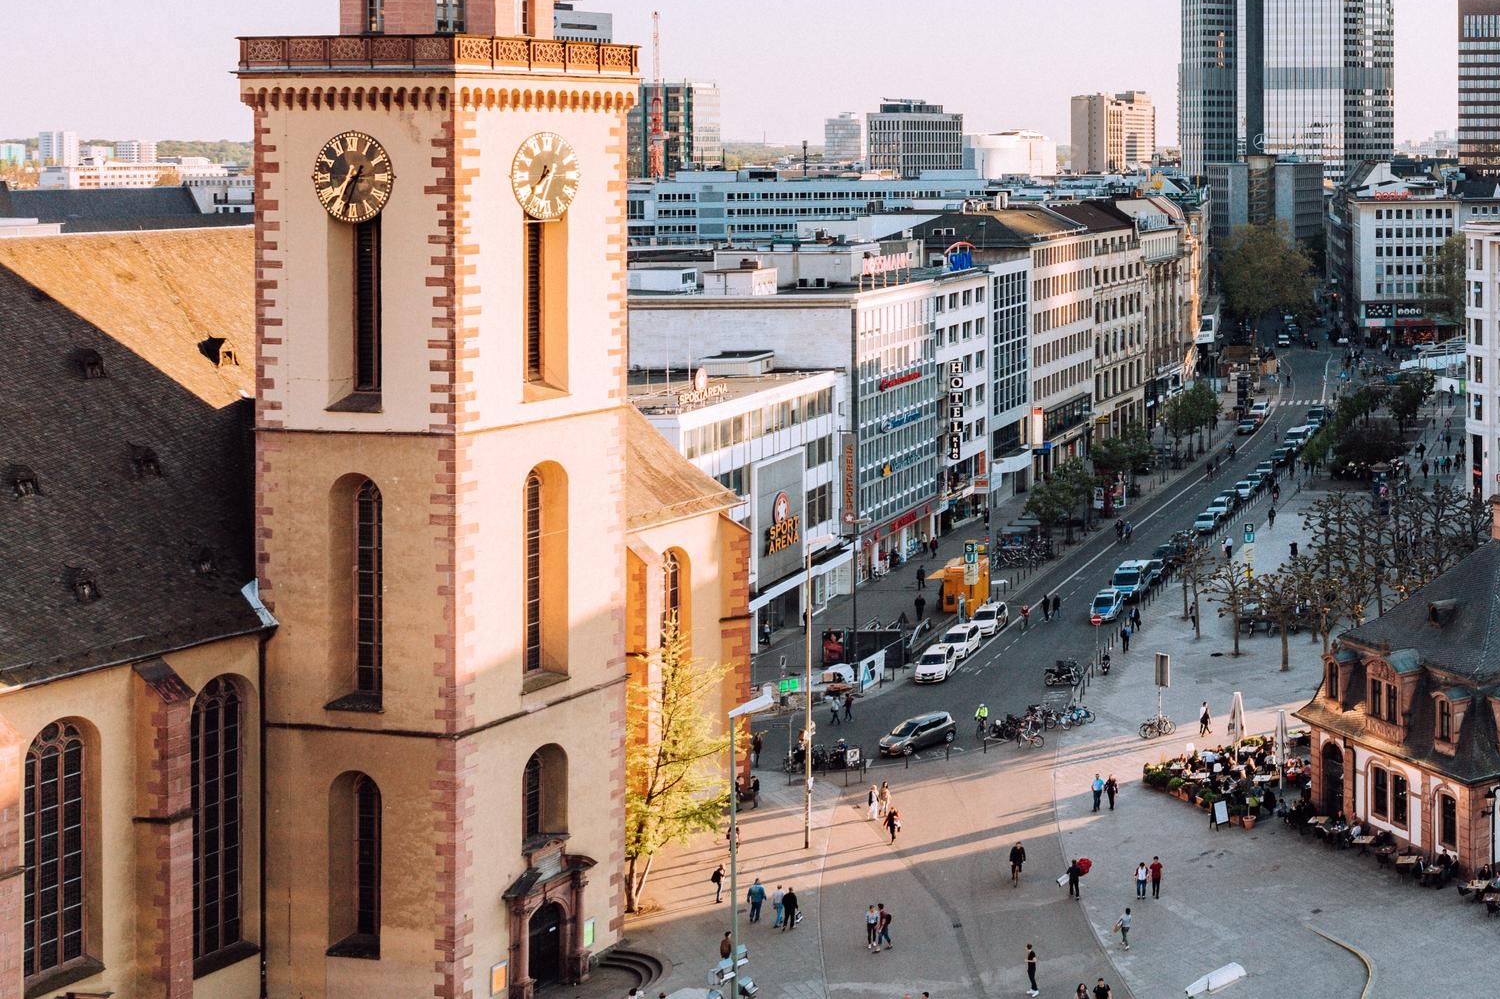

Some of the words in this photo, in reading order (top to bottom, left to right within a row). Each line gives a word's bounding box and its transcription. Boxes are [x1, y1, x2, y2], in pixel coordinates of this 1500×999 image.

[951, 362, 963, 432] HOTEL
[769, 515, 799, 540] SPORT
[768, 531, 800, 554] ARENA
[965, 553, 974, 563] U
